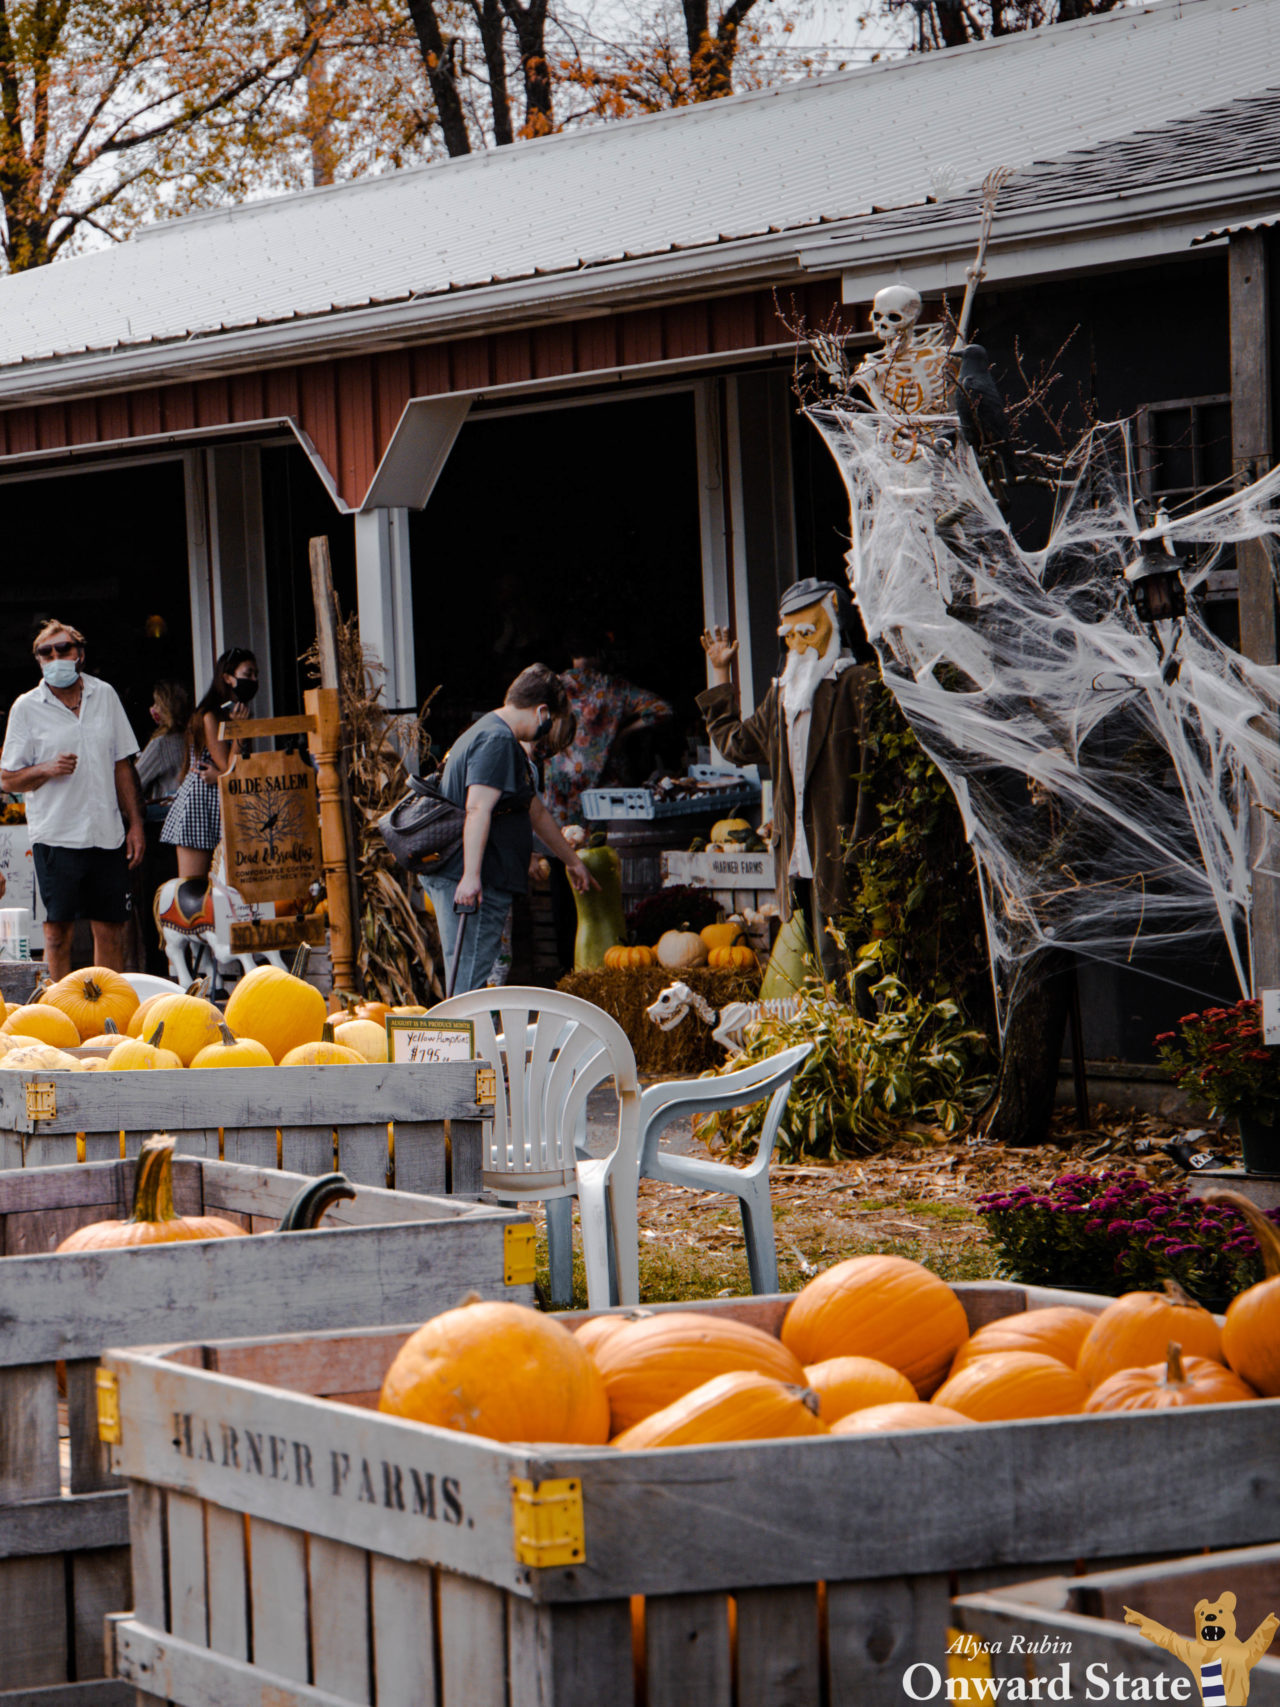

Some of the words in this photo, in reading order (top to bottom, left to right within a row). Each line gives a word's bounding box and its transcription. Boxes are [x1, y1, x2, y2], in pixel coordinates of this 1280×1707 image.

[229, 778, 262, 795] OLDE
[265, 774, 308, 791] SALEM
[236, 851, 258, 866] Dead
[263, 848, 271, 866] &
[273, 843, 313, 864] Breakfast
[713, 861, 739, 874] HARNER
[741, 861, 763, 874] FARMS
[232, 925, 252, 946] NO
[408, 1031, 435, 1046] Yellow
[172, 1411, 315, 1489] HARNER
[330, 1450, 475, 1530] FARMS.
